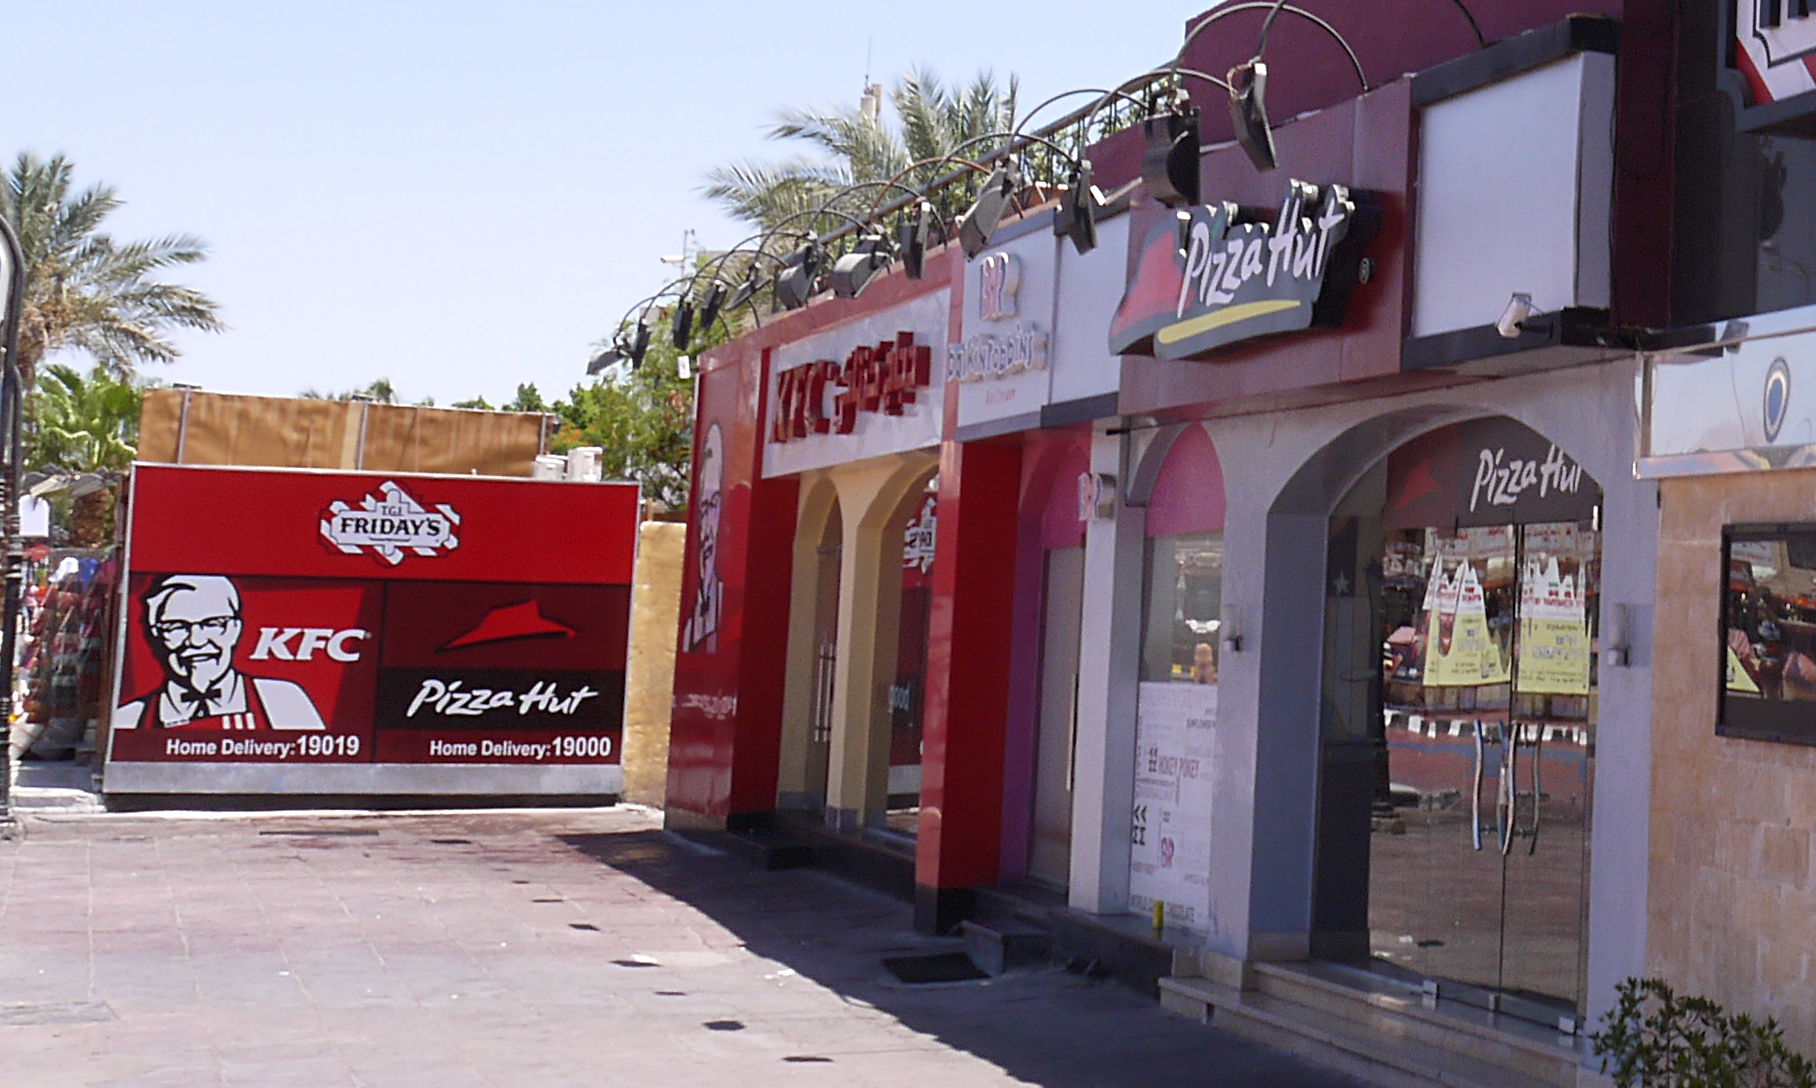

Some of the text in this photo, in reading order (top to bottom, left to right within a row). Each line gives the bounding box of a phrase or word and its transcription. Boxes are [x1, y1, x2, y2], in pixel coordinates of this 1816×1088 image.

[1177, 197, 1346, 319] Pizza Hut
[1470, 447, 1538, 512] Pizza
[340, 517, 441, 536] FRIDAY'S
[249, 627, 366, 661] KFC
[406, 679, 599, 717] Pizza Hut
[166, 738, 217, 756] Home
[430, 740, 477, 756] Home
